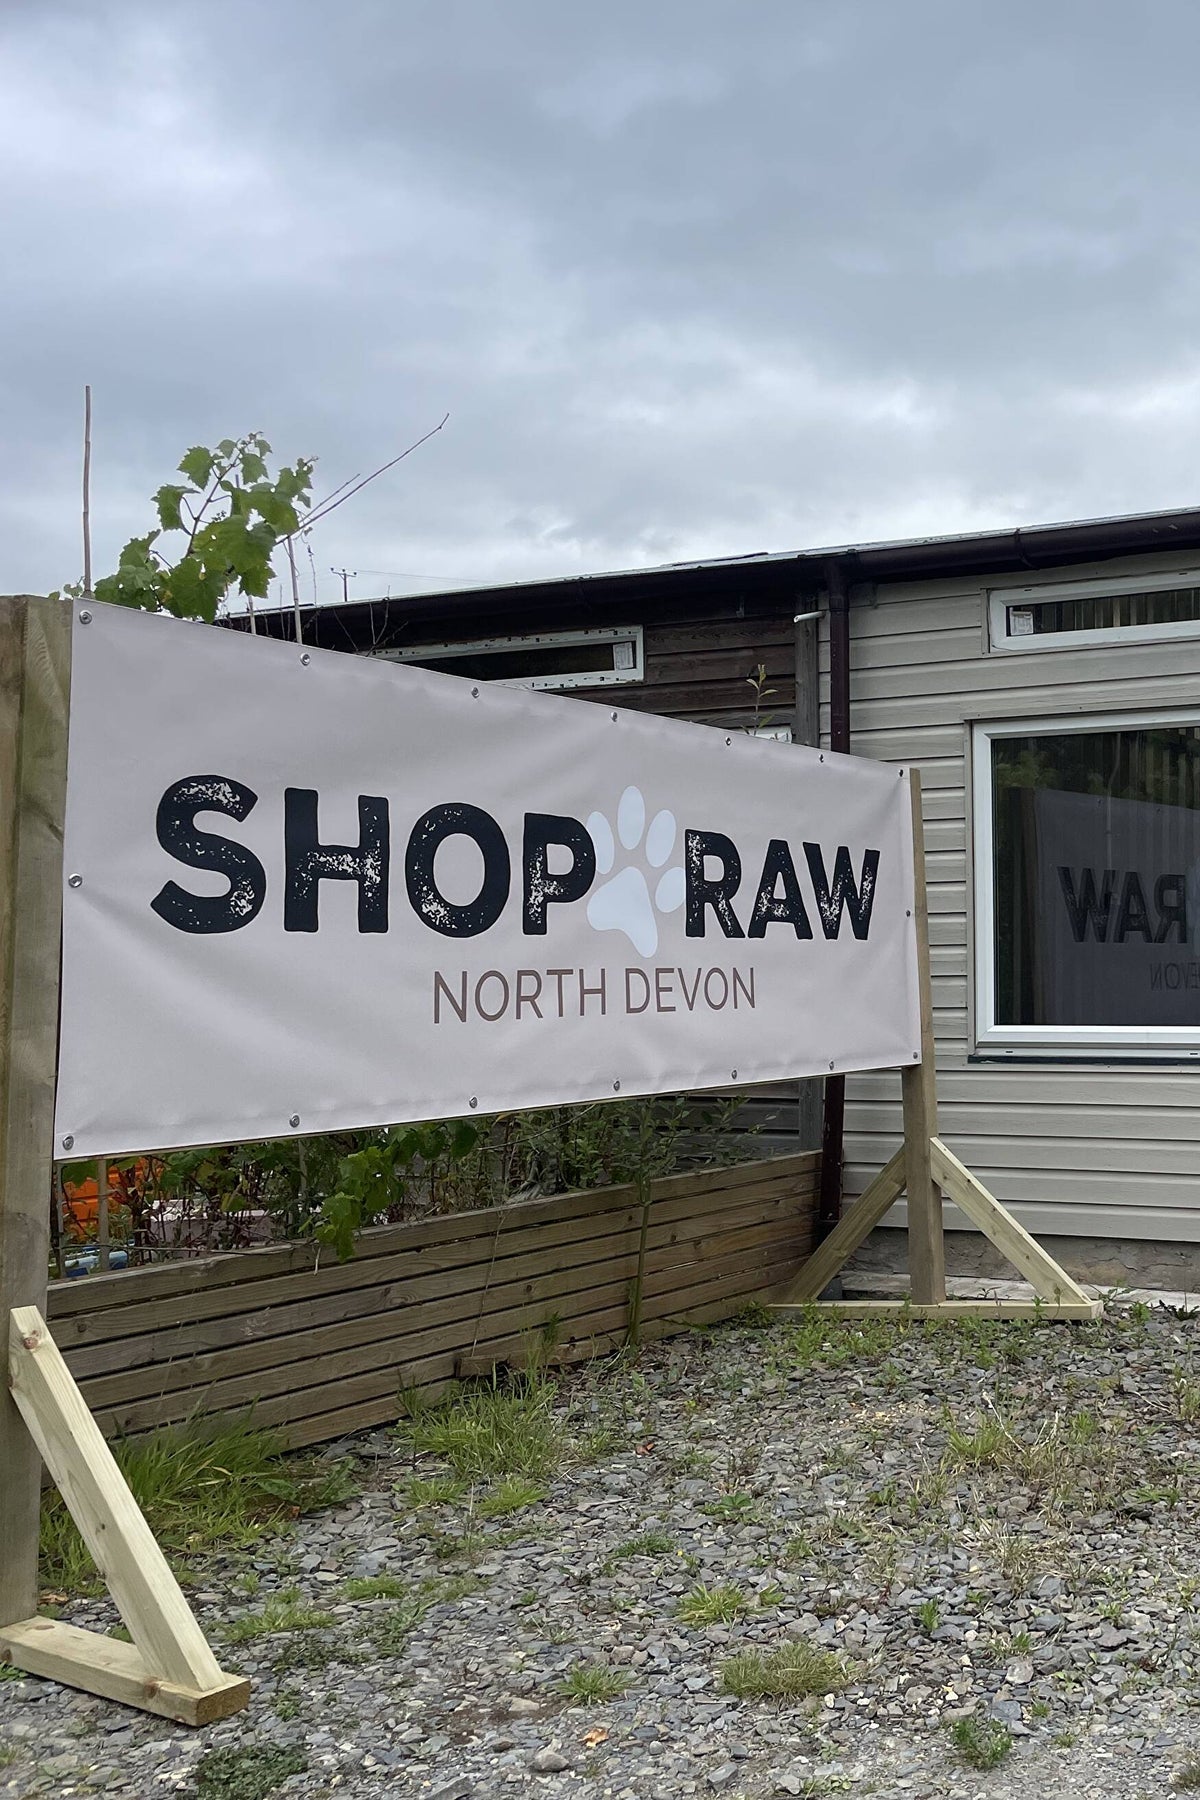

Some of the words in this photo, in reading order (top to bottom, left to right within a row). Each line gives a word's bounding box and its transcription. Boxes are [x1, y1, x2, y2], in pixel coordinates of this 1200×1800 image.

[151, 774, 597, 938] SHOP
[684, 829, 881, 941] RAW
[433, 966, 607, 1024] NORTH
[625, 966, 757, 1016] DEVON
